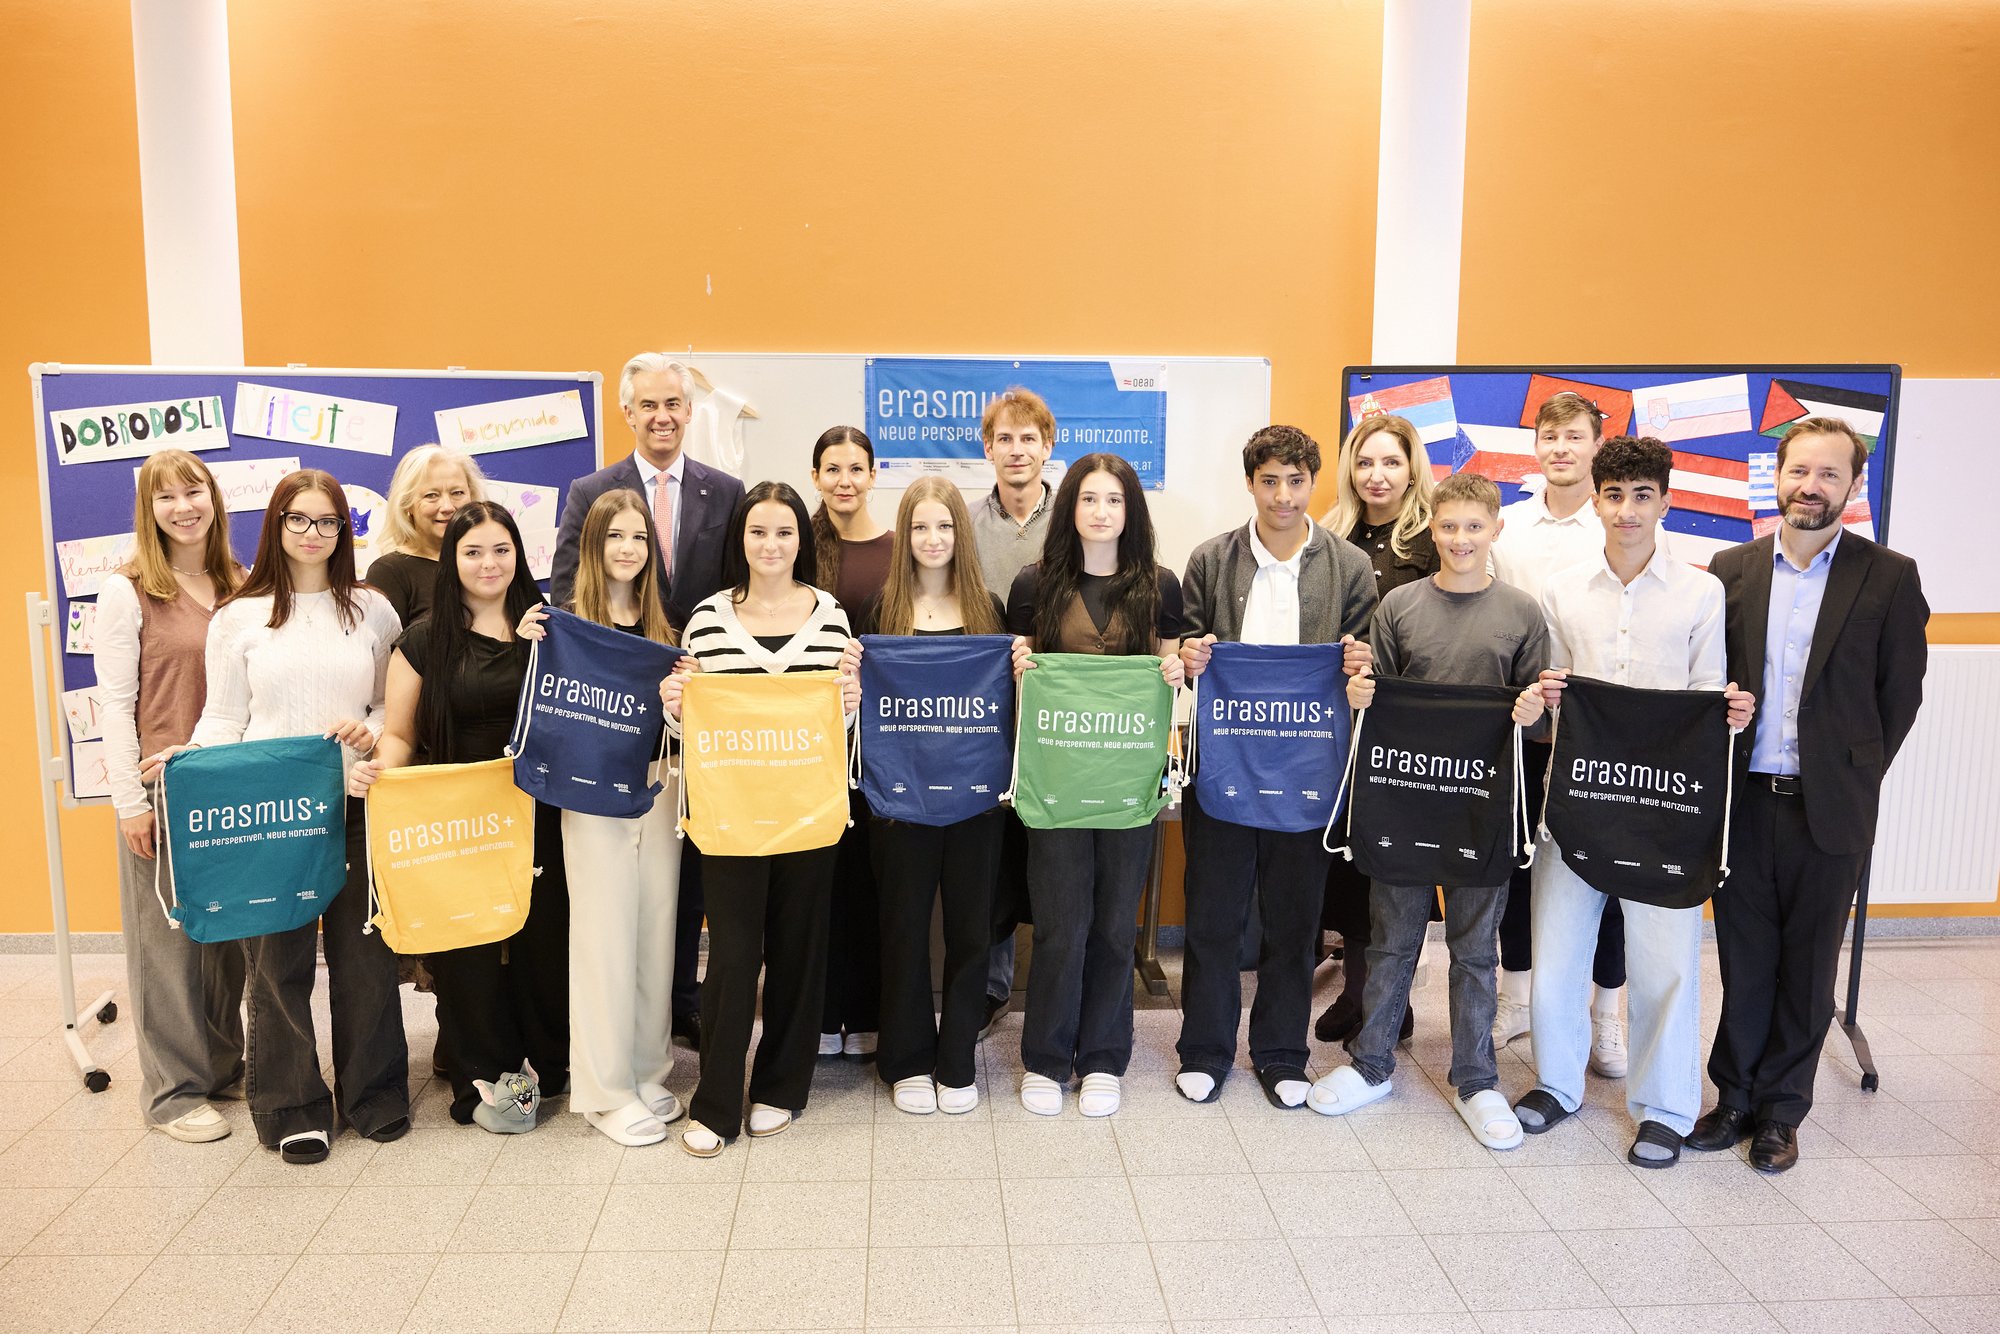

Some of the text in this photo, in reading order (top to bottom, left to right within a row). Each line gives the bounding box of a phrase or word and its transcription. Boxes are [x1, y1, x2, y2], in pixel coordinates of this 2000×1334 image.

[878, 388, 1015, 418] erasmu
[922, 426, 982, 442] Perspek
[540, 673, 647, 717] erasmus+
[879, 695, 999, 719] erasmus+
[1038, 709, 1156, 735] erasmus+
[1213, 698, 1335, 723] erasmus+
[698, 728, 824, 754] erasmus+
[1371, 745, 1497, 780] erasmus+
[1571, 757, 1703, 796] erasmus+
[188, 797, 328, 833] erasmus+
[388, 813, 515, 854] erasmus+
